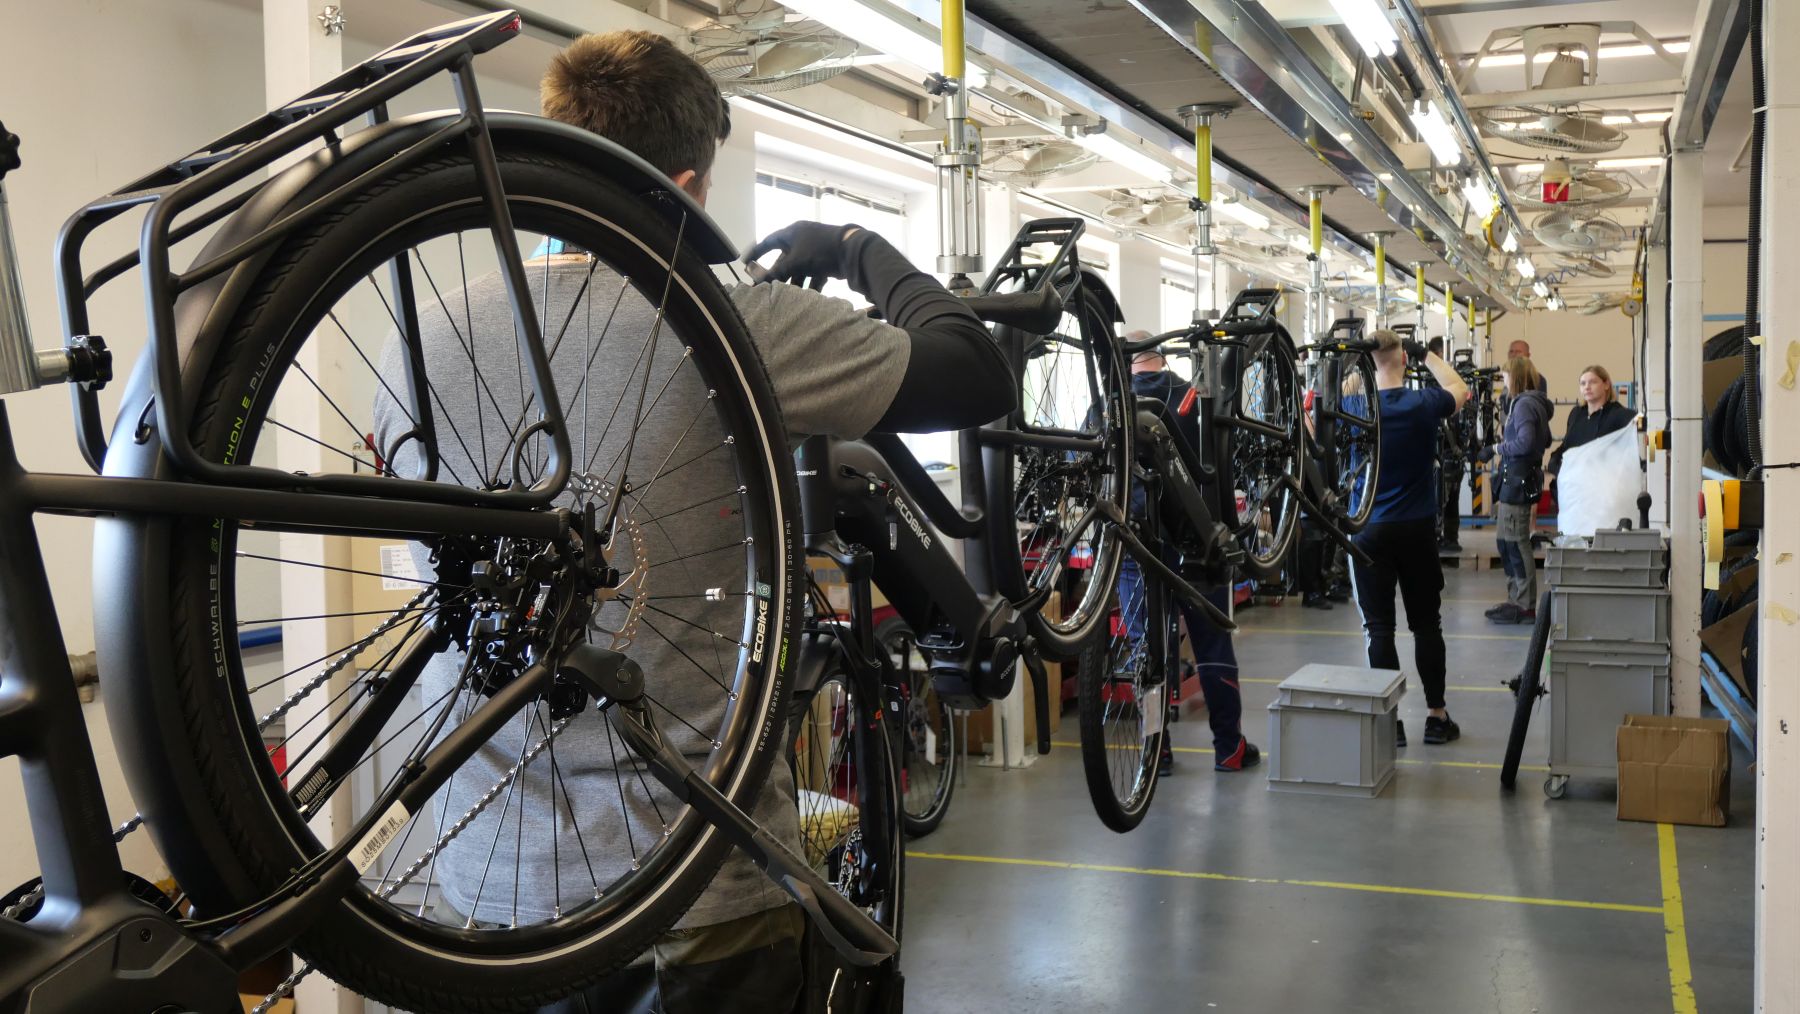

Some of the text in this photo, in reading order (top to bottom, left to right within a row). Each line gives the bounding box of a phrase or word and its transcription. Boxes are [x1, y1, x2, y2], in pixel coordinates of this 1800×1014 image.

[210, 563, 225, 679] SCHWALBE
[241, 395, 251, 409] E
[250, 343, 275, 391] PLUS
[894, 496, 932, 550] ECOBIKE
[753, 600, 768, 664] ECOBIKE
